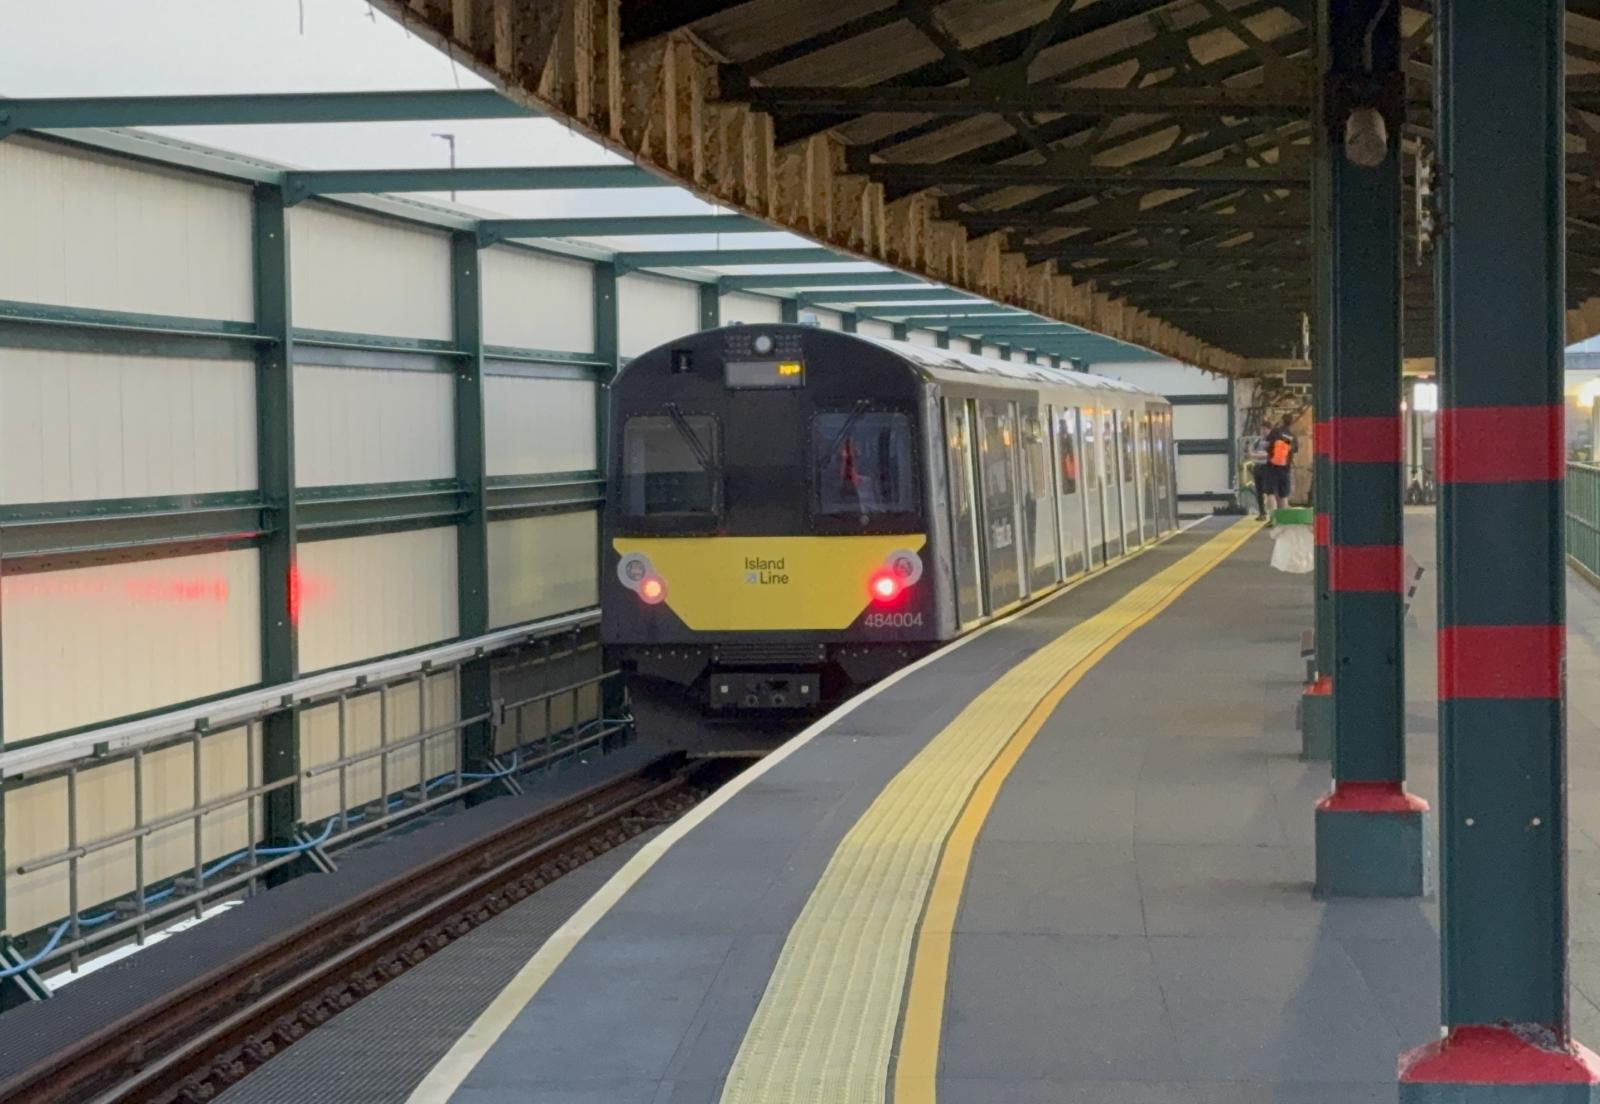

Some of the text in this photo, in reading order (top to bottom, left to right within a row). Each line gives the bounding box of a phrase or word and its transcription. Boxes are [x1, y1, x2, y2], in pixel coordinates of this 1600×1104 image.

[745, 556, 785, 570] Island
[760, 571, 789, 584] Line
[864, 612, 924, 627] 484004
